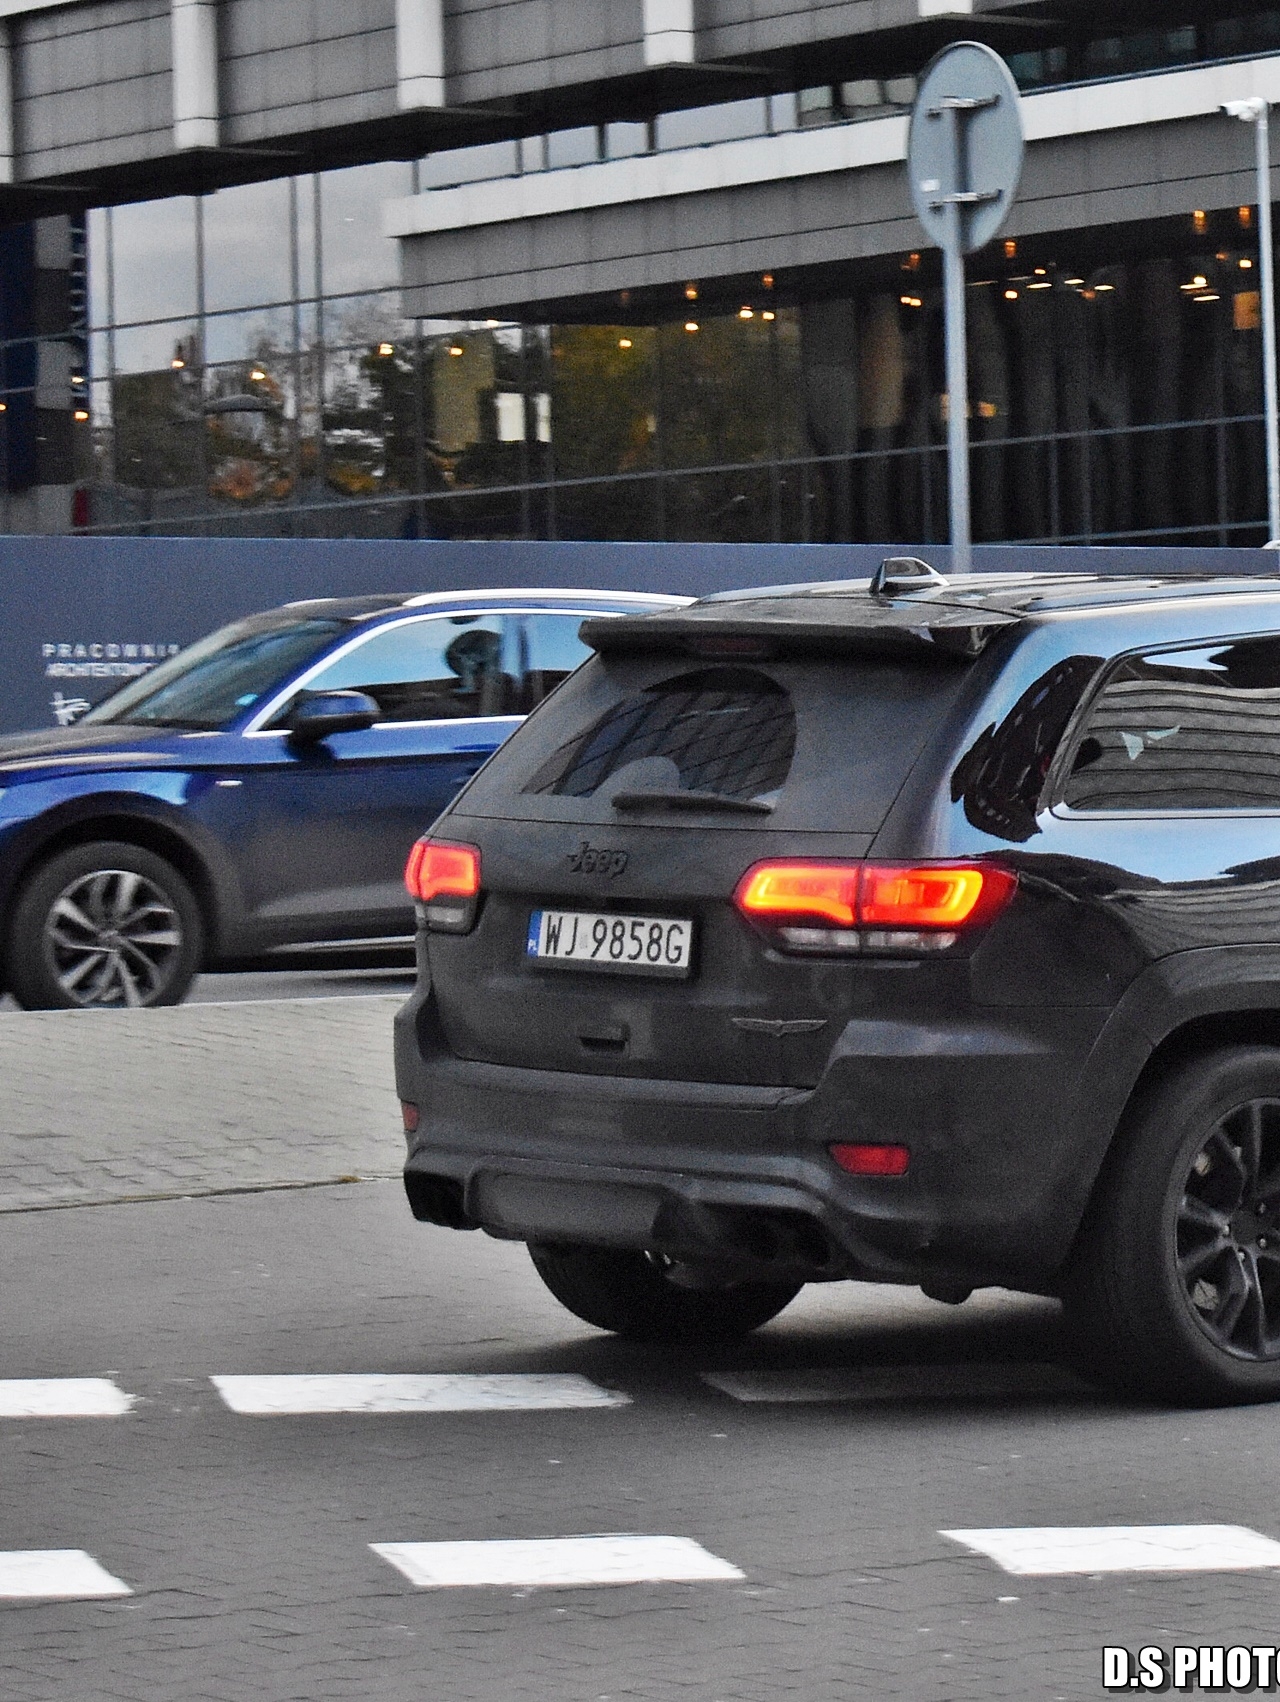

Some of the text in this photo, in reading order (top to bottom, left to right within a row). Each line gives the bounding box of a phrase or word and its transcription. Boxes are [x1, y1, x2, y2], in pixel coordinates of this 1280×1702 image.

[567, 841, 630, 879] Jeep
[545, 914, 684, 965] WJ 9858G
